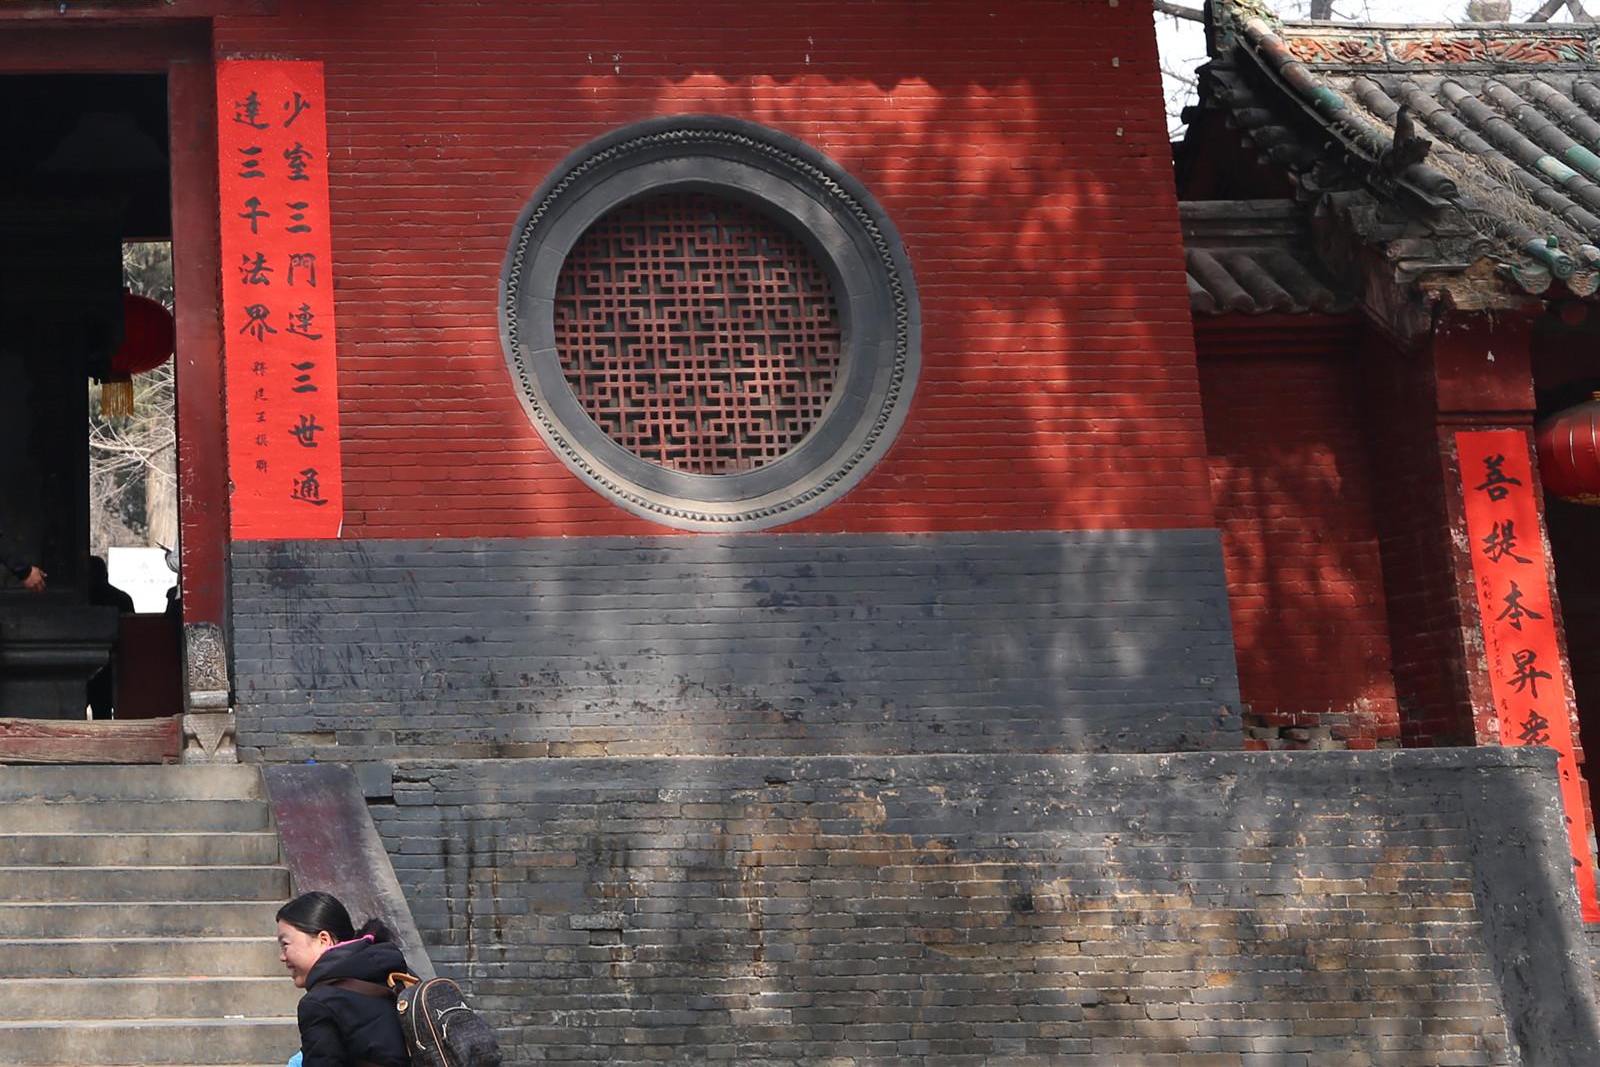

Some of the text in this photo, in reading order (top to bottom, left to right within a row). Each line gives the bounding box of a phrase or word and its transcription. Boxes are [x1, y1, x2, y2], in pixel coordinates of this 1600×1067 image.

[232, 91, 277, 343] 達三千法界
[281, 91, 328, 506] 少室三門連三世通
